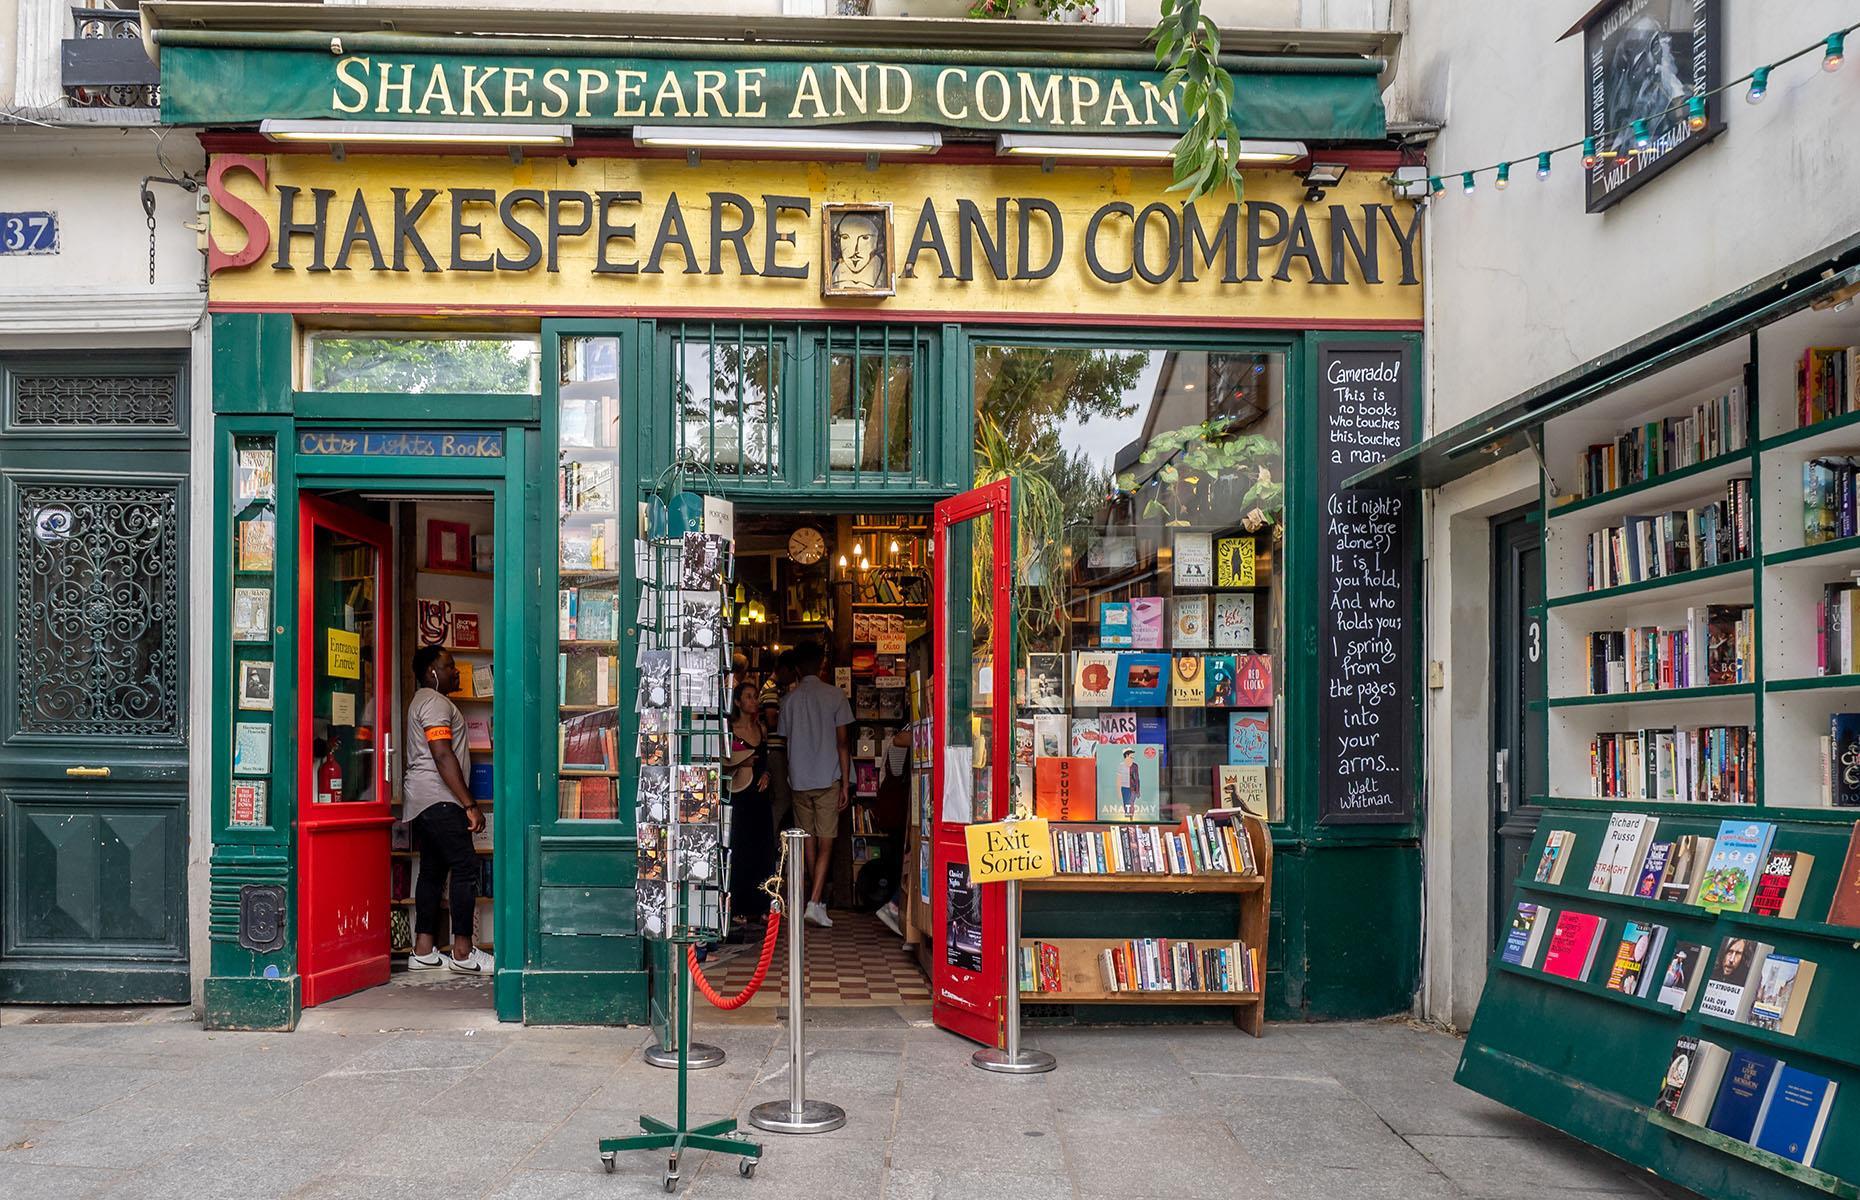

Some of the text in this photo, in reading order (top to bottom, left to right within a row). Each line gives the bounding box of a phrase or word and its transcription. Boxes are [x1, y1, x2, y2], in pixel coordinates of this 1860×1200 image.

[332, 56, 767, 119] SHAKESPEARE
[788, 64, 914, 119] AND
[1603, 119, 1692, 193] WALT WHITMAN
[209, 153, 1427, 286] SHAKESPEARE AND COMPANY
[5, 215, 50, 250] 37
[1327, 360, 1401, 384] Camerado!
[1333, 387, 1386, 403] This is
[1339, 403, 1398, 416] no book;
[1356, 416, 1400, 430] touches
[363, 434, 435, 456] Lights
[1330, 430, 1401, 447] this, touches
[1331, 450, 1387, 464] a man:
[1347, 494, 1357, 515] it
[1362, 494, 1402, 521] night?
[1328, 518, 1397, 536] Are we here
[1336, 534, 1392, 554] alone?)
[1331, 554, 1343, 573] It
[1353, 554, 1367, 570] is
[1333, 569, 1401, 593] you hold,
[1330, 590, 1396, 611] And who
[1336, 611, 1402, 639] holds you;
[330, 636, 359, 656] Entrance
[1347, 638, 1397, 664] spring
[1528, 621, 1541, 663] 3
[1248, 668, 1260, 680] RED
[1341, 655, 1381, 681] from
[1243, 679, 1265, 691] CLOCKS
[1329, 678, 1397, 706] the pages
[1101, 717, 1136, 734] MARS
[1343, 705, 1380, 728] into
[1337, 733, 1380, 758] your
[1348, 777, 1380, 795] Walt
[1101, 804, 1157, 814] ANATOMY
[1339, 793, 1394, 809] Whitman
[1609, 816, 1641, 829] Richard
[986, 829, 1030, 853] Exit
[1611, 830, 1636, 842] Russo
[979, 850, 1043, 876] Sortie
[1771, 856, 1791, 867] JOHN
[1715, 983, 1741, 995] STRUGGLE
[1701, 1003, 1736, 1016] KNAUSGAARD
[1704, 996, 1727, 1007] KARL OVE
